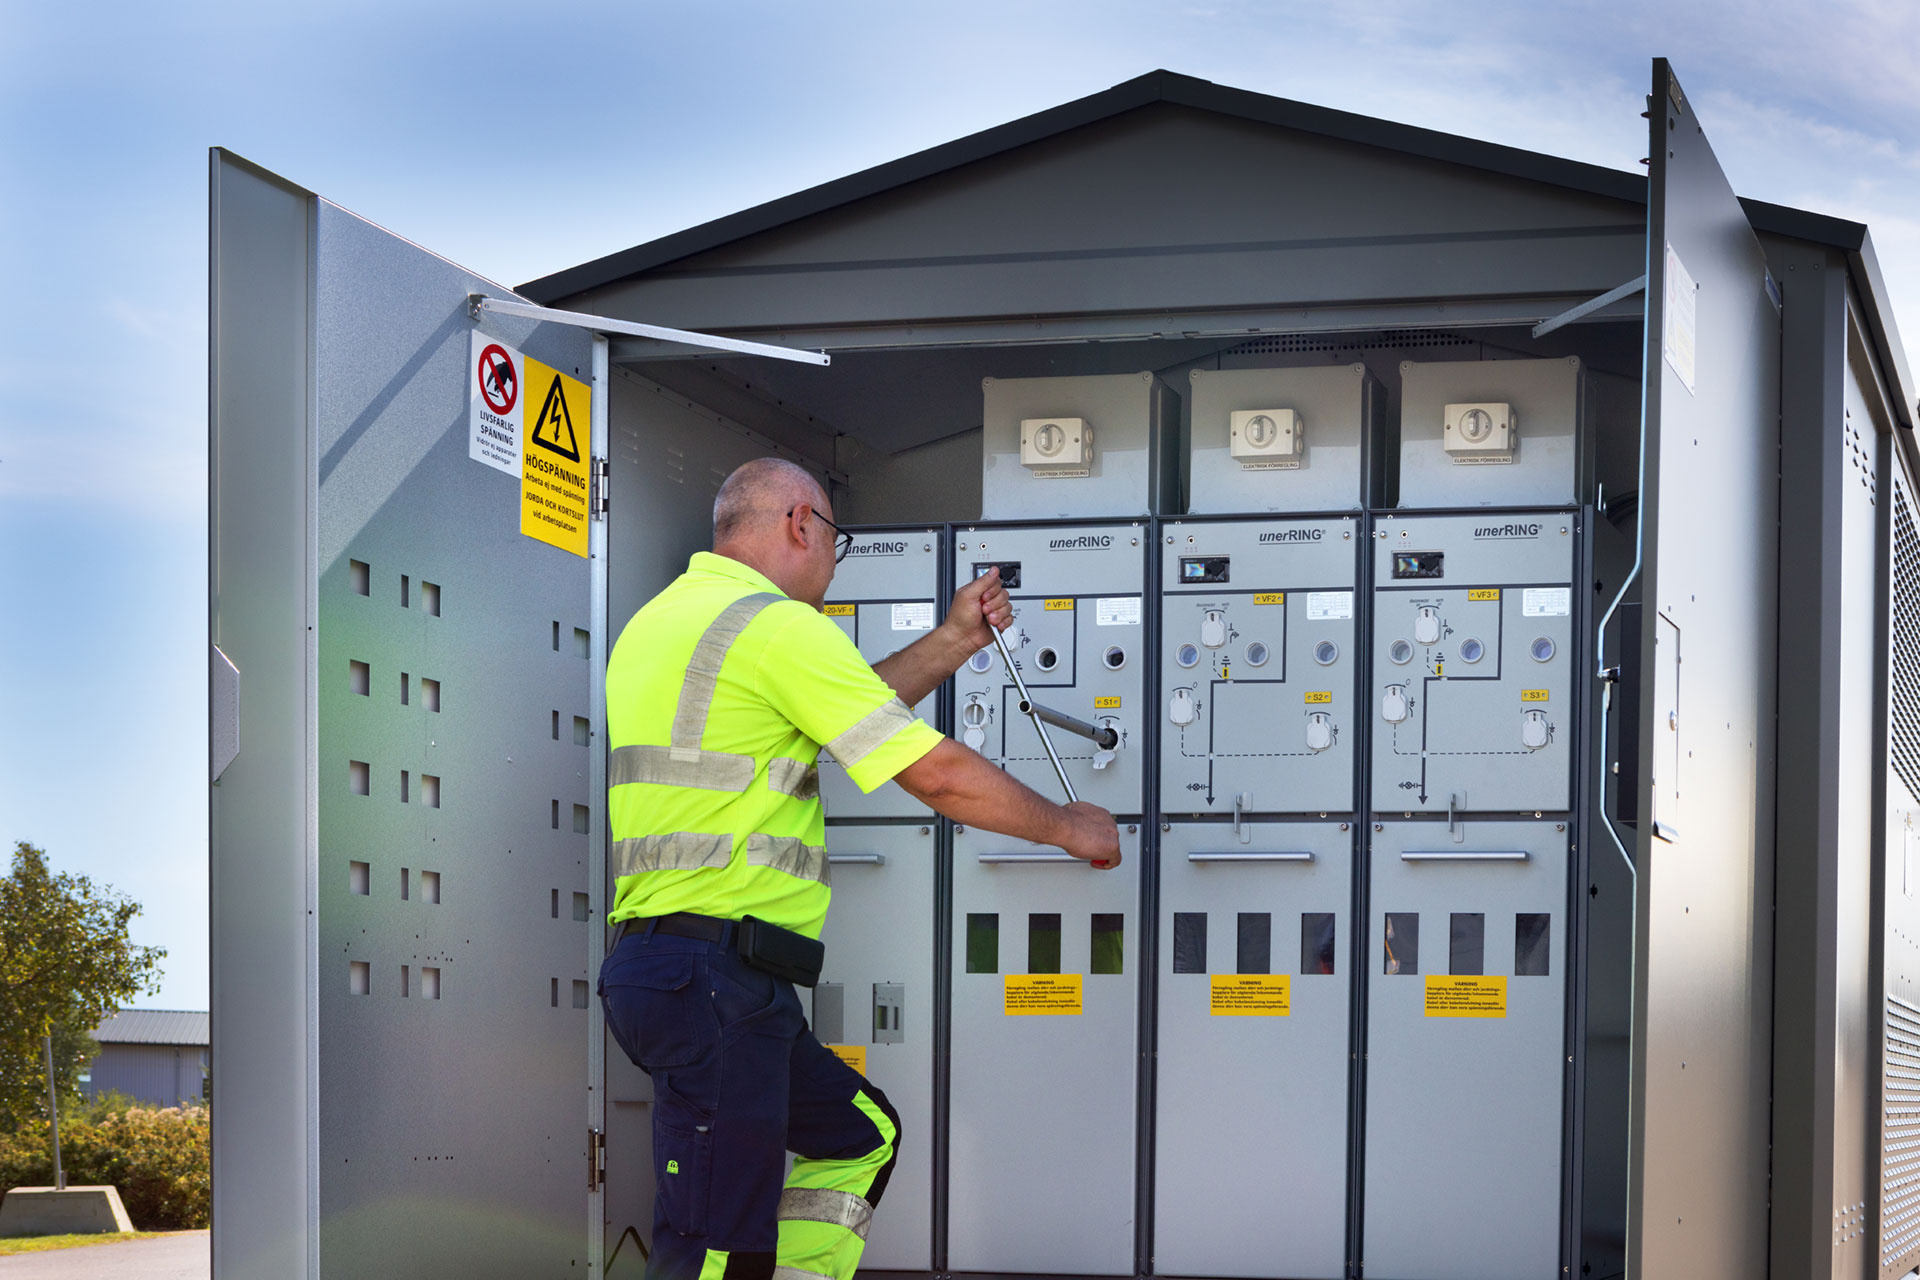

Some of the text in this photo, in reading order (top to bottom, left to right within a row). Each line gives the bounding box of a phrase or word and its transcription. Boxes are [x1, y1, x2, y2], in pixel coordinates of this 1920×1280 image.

[480, 410, 514, 432] LIVSFARLIG
[481, 424, 513, 446] SPÄNNING
[526, 454, 585, 489] HÖGSPÄNNING
[526, 472, 585, 505] Arbeta ej med spänning
[526, 492, 584, 521] JORDA OCH KORTSLUT
[533, 510, 576, 533] vid arbetsplatsen
